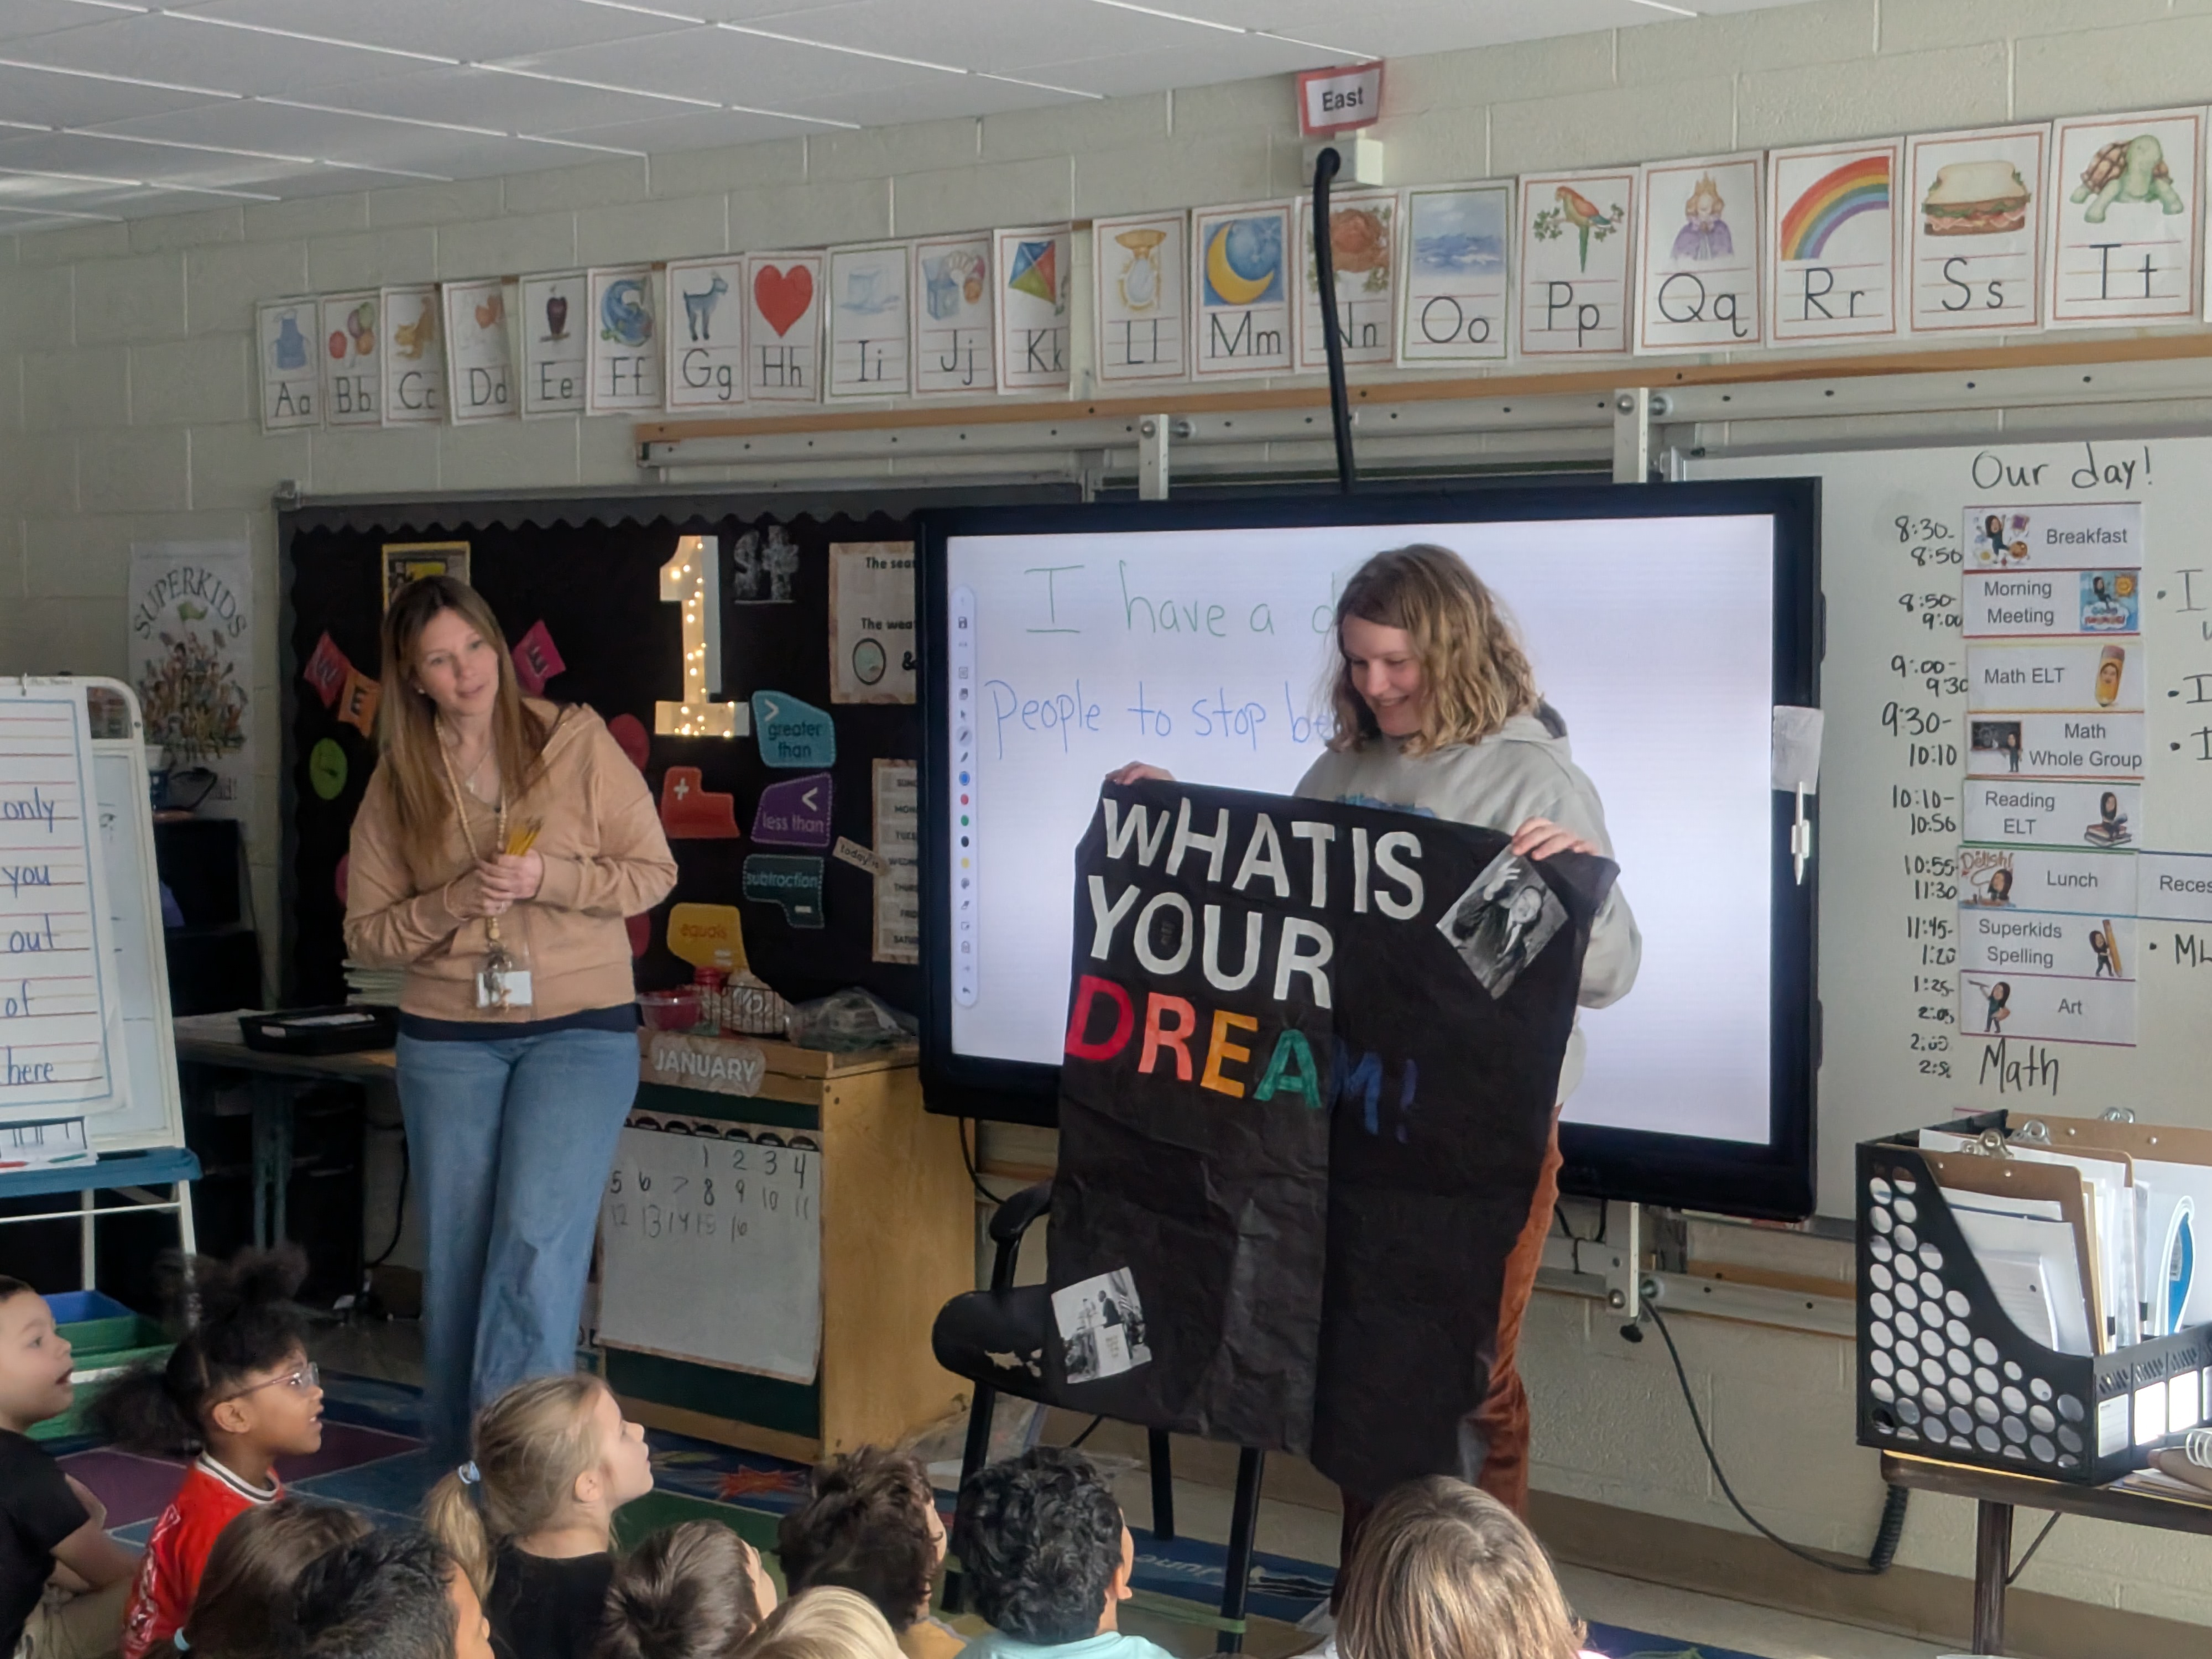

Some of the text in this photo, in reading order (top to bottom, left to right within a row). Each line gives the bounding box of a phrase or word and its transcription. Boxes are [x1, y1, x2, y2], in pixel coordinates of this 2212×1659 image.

[1322, 87, 1364, 112] East
[1972, 442, 2153, 489] Our day!
[2046, 529, 2127, 545] Breakfast
[866, 557, 887, 569] The
[1024, 565, 1084, 634] I
[1118, 559, 1227, 637] have
[1250, 603, 1275, 635] a
[1984, 581, 2052, 599] Morning
[134, 566, 247, 640] SUPERKIDS
[861, 617, 914, 630] The wea
[1987, 609, 2054, 626] Meeting
[1984, 668, 2065, 685] Math ELT
[984, 679, 1102, 760] People
[1128, 681, 1172, 737] to
[1192, 688, 1267, 750] stop
[768, 722, 823, 741] greater
[2064, 723, 2106, 739] Math
[778, 741, 812, 758] than
[1910, 743, 1957, 767] 10:10
[2030, 751, 2143, 770] Whole Group
[4, 786, 55, 833] only
[1985, 791, 2055, 812] Reading
[762, 813, 824, 832] less than
[2004, 819, 2036, 835] ELT
[1103, 797, 1423, 920] WHAT IS
[2, 864, 52, 899] you
[746, 870, 820, 888] subtraction
[1914, 879, 1958, 900] 11:30
[2047, 871, 2098, 888] Lunch
[9, 913, 60, 953] out
[1979, 919, 2063, 939] Superkids
[1088, 875, 1334, 1010] YOUR
[1987, 947, 2054, 968] Spelling
[5, 978, 33, 1016] of
[2058, 998, 2082, 1015] Art
[7, 1045, 54, 1085] here
[654, 1048, 757, 1082] JANUARY
[1979, 1037, 2059, 1096] Math
[732, 1150, 748, 1171] 2
[764, 1150, 778, 1176] 3
[794, 1153, 807, 1190] 4
[609, 1170, 623, 1194] 5
[703, 1178, 715, 1207] 8
[735, 1179, 746, 1203] 9
[762, 1187, 779, 1211] 10
